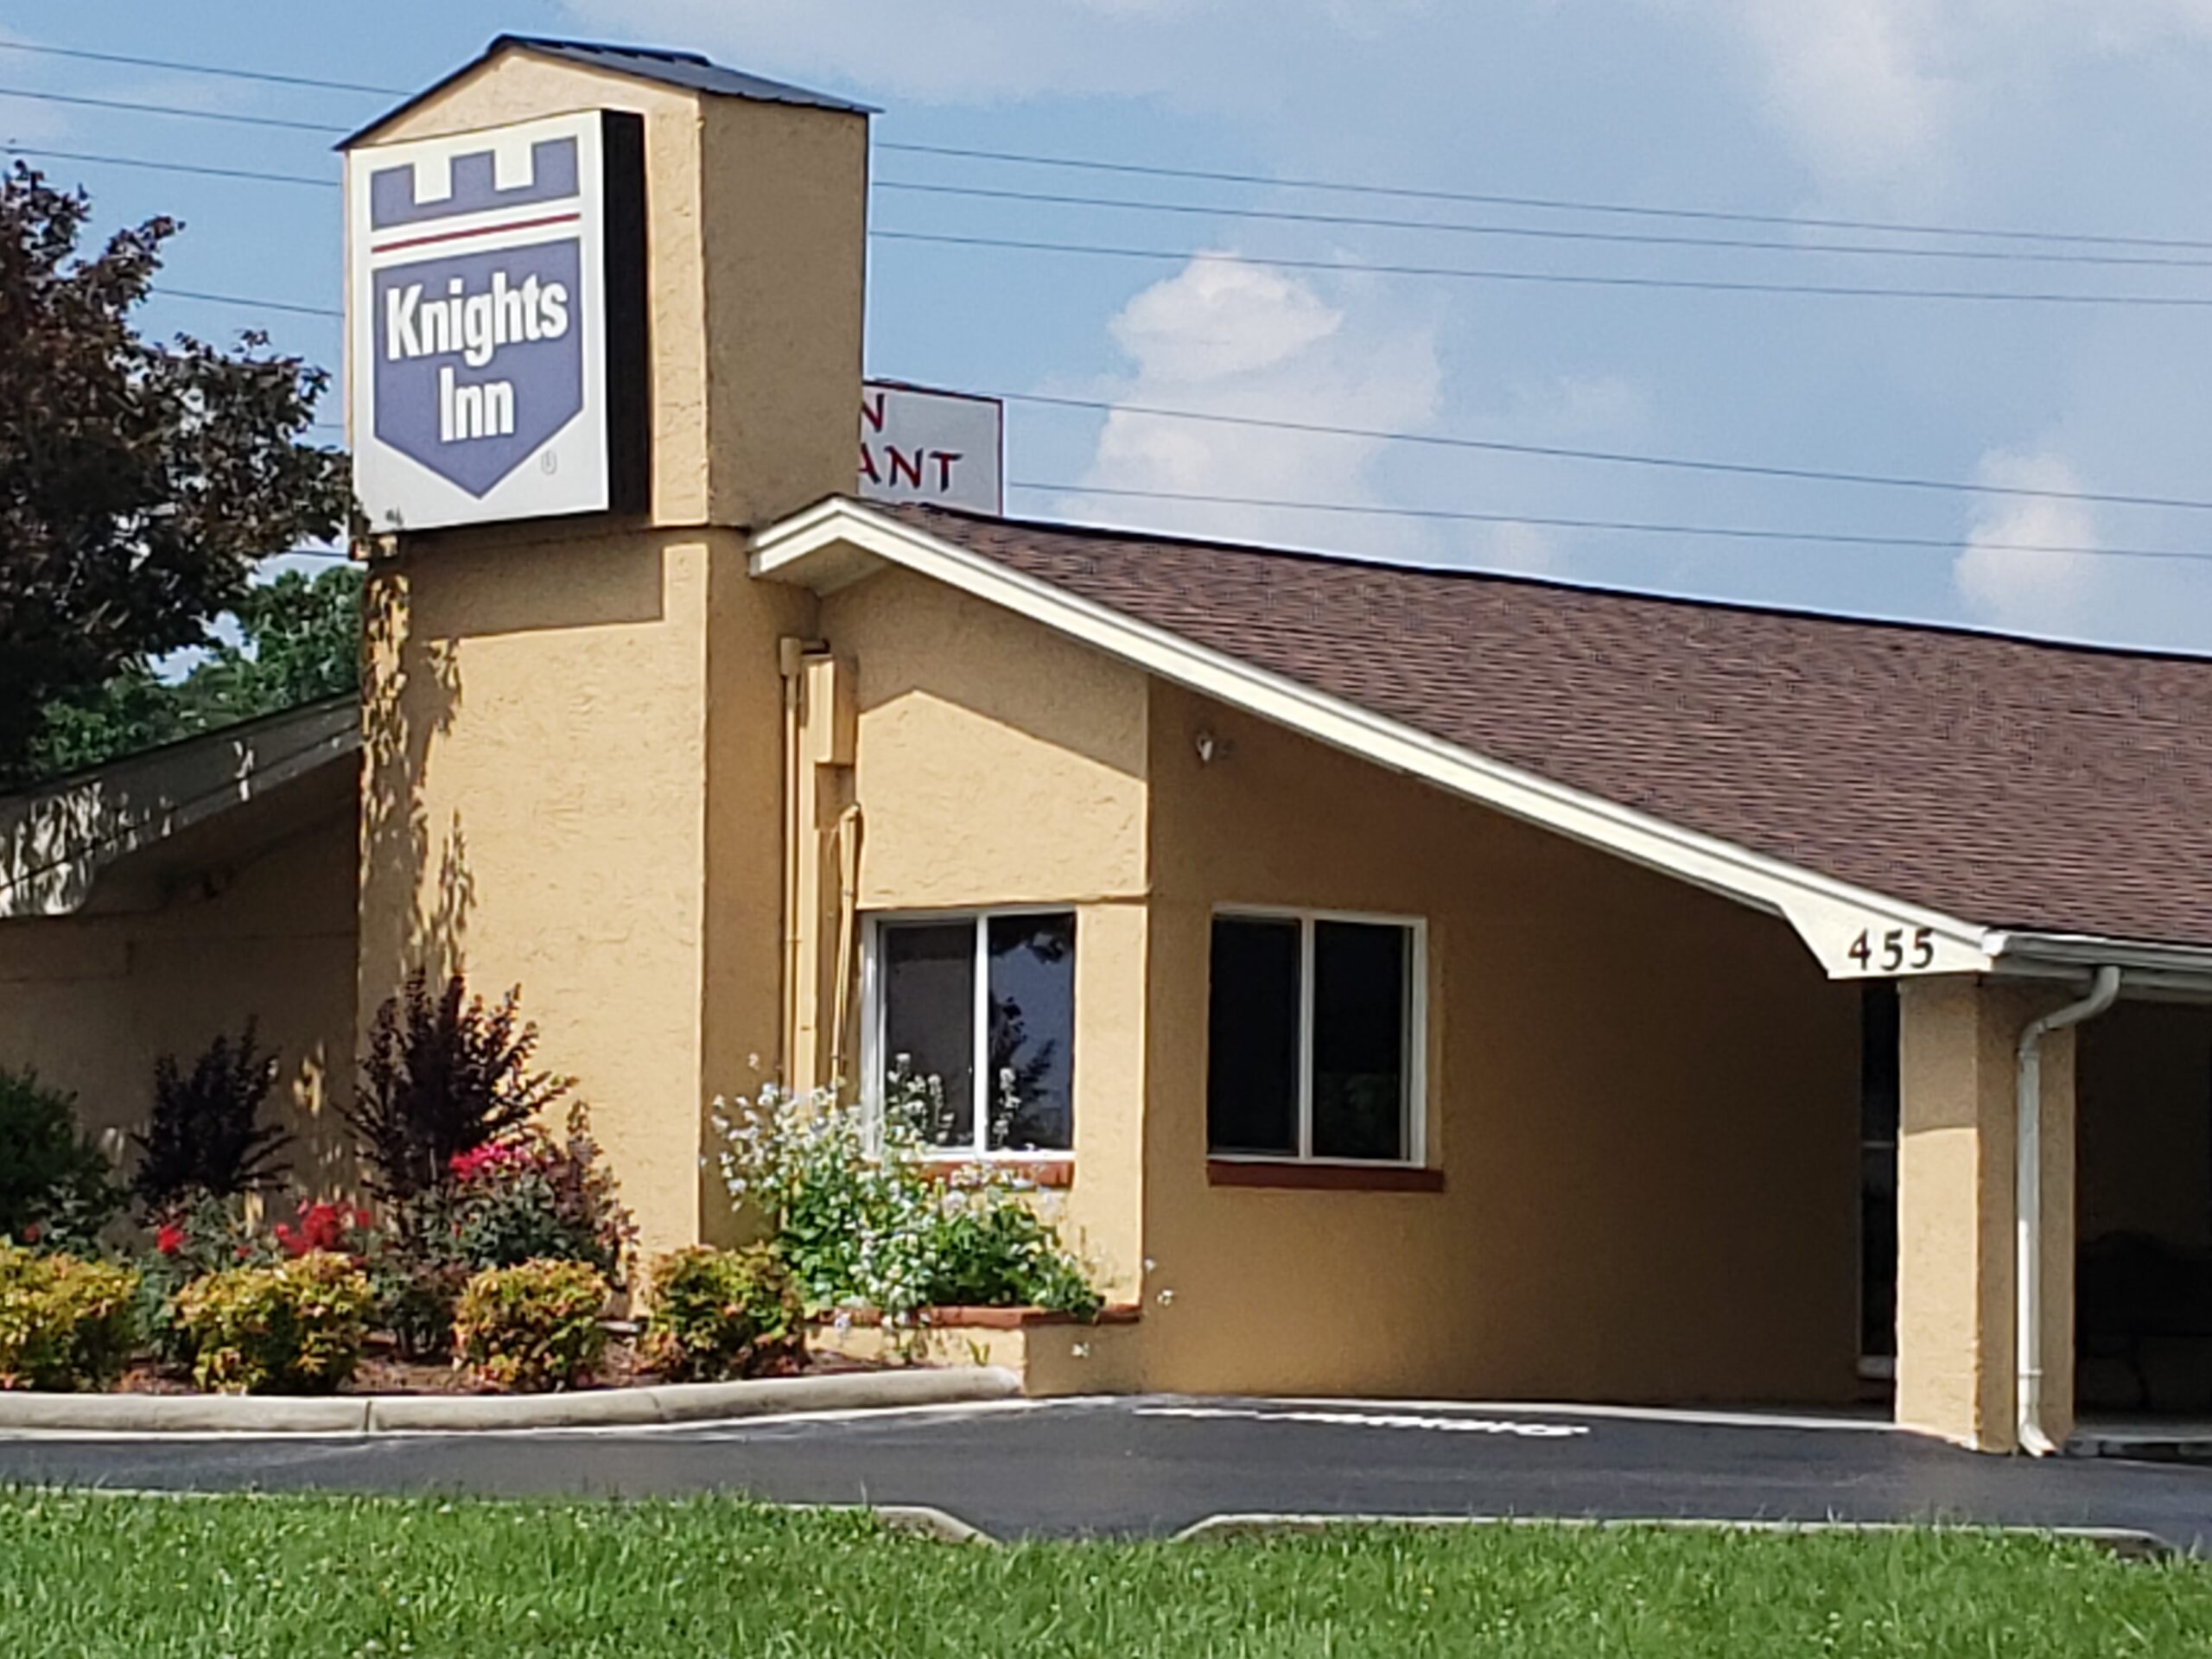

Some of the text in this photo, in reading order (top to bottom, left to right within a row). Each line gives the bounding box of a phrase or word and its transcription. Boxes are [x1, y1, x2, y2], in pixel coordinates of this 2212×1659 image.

[386, 271, 569, 367] Knights
[440, 366, 515, 442] Inn
[1847, 927, 1935, 971] 455
